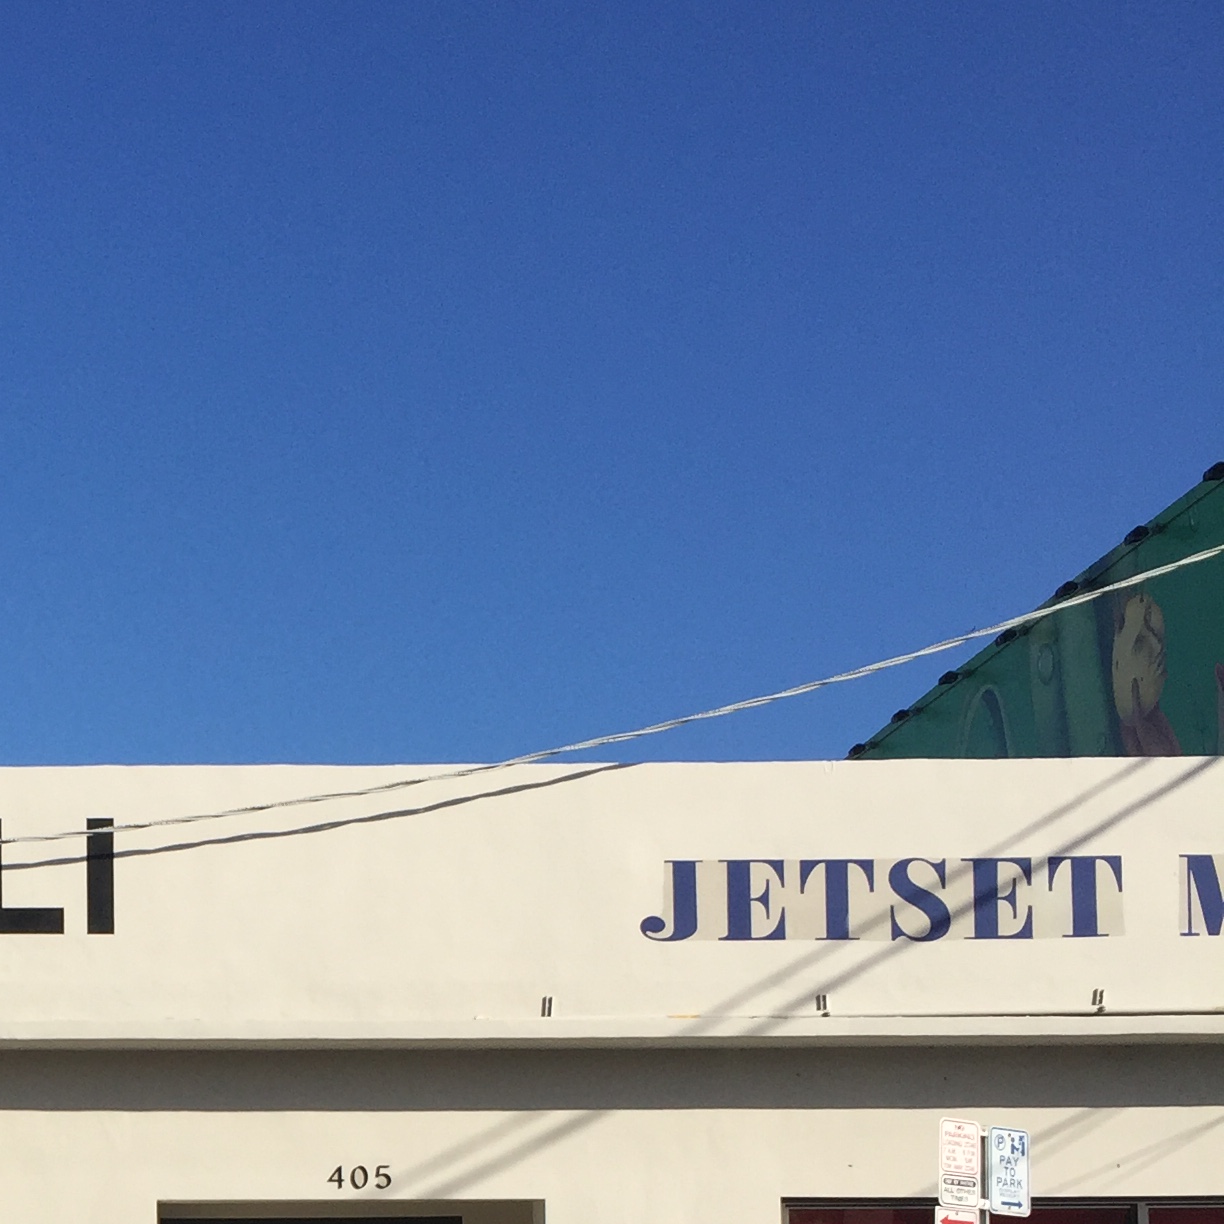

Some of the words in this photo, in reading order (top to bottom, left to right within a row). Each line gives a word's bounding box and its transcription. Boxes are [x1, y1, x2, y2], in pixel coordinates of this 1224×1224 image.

[639, 855, 1124, 942] JETSET
[999, 1155, 1019, 1167] PAY
[326, 1164, 392, 1190] 405
[1004, 1166, 1016, 1178] TO
[996, 1176, 1023, 1190] PARK
